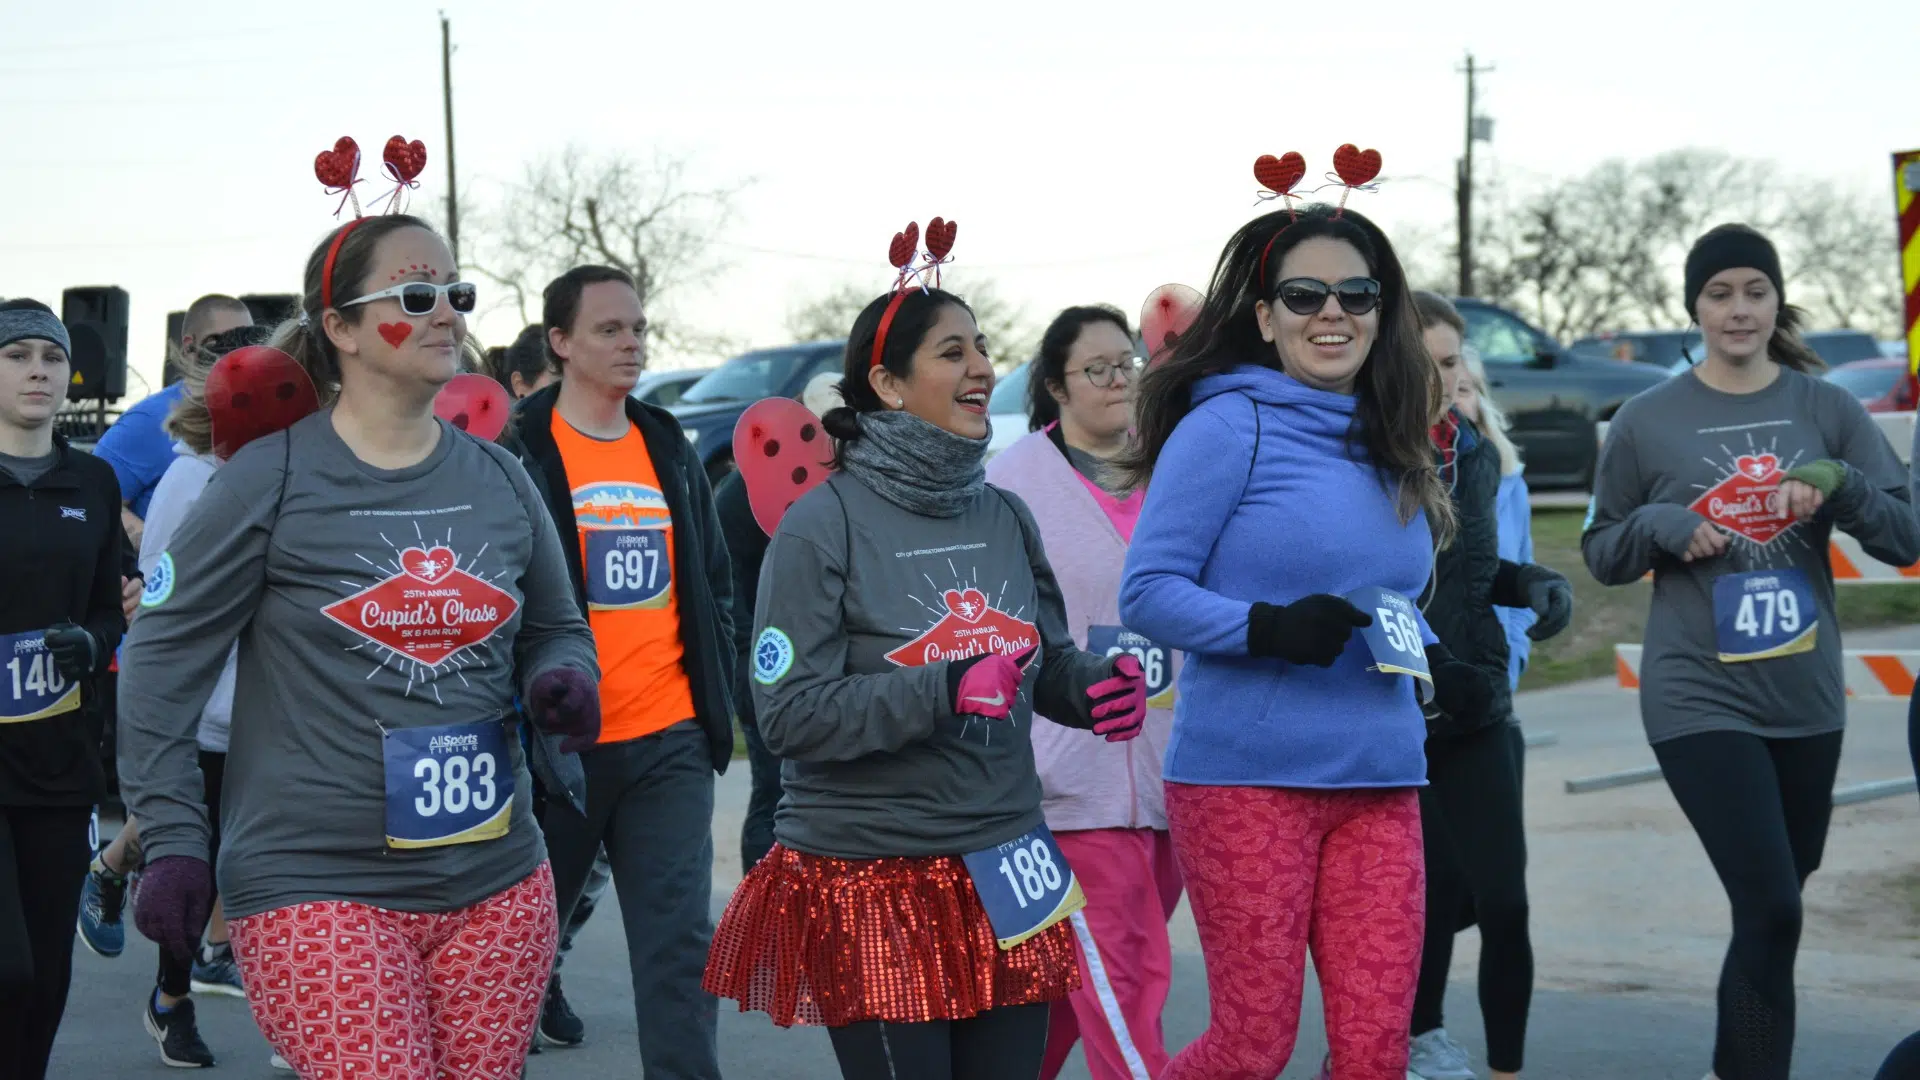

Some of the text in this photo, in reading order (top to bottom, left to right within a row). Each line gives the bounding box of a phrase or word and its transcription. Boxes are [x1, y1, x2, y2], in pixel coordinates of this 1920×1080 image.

[605, 549, 659, 590] 697
[403, 588, 462, 598] 25TH ANNUAL
[360, 598, 498, 632] Cupid's Chase
[1735, 589, 1801, 636] 479
[401, 629, 414, 638] 5K
[423, 629, 441, 637] FUN
[442, 628, 462, 636] RUN
[953, 625, 1000, 638] 25TH ANNUAL
[429, 733, 479, 747] AllSports
[429, 745, 479, 755] TIMING
[414, 752, 496, 817] 383
[997, 834, 1030, 854] TIMING
[998, 838, 1062, 909] 188
